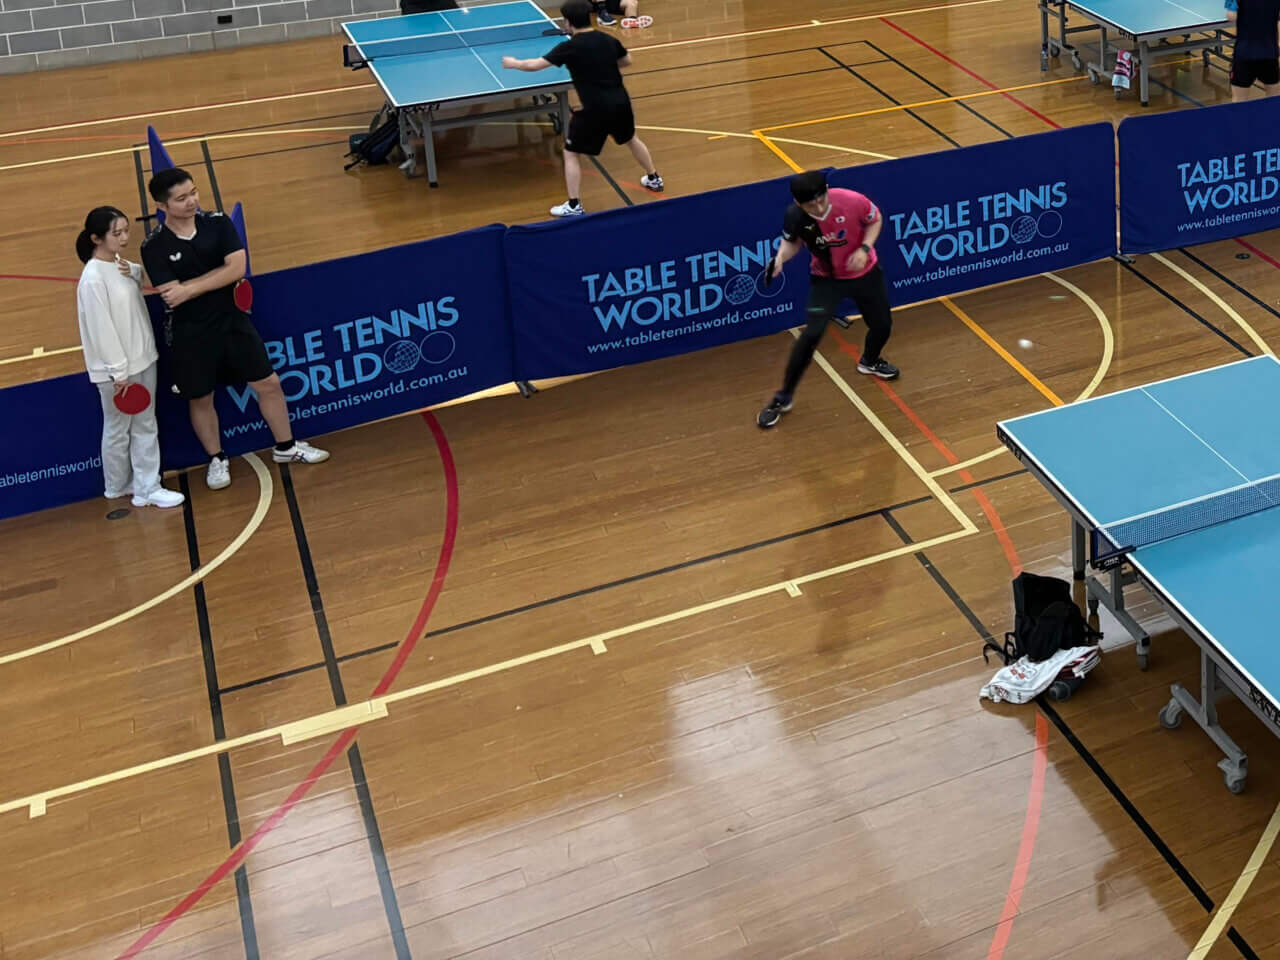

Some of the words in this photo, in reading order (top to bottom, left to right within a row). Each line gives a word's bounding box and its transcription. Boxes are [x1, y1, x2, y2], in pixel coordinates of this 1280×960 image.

[1177, 154, 1246, 188] TABLE
[889, 200, 971, 241] TABLE
[978, 181, 1068, 222] TENNIS
[1183, 176, 1279, 215] WORLD
[892, 242, 1071, 289] www.tabletennisworld.com.au
[899, 223, 1010, 269] WORLD
[582, 261, 678, 303] TABLE
[587, 301, 795, 354] www.tabletennisworld.com.au
[593, 283, 724, 333] WORLD
[263, 329, 326, 370] BLE
[333, 296, 460, 353] TENNIS
